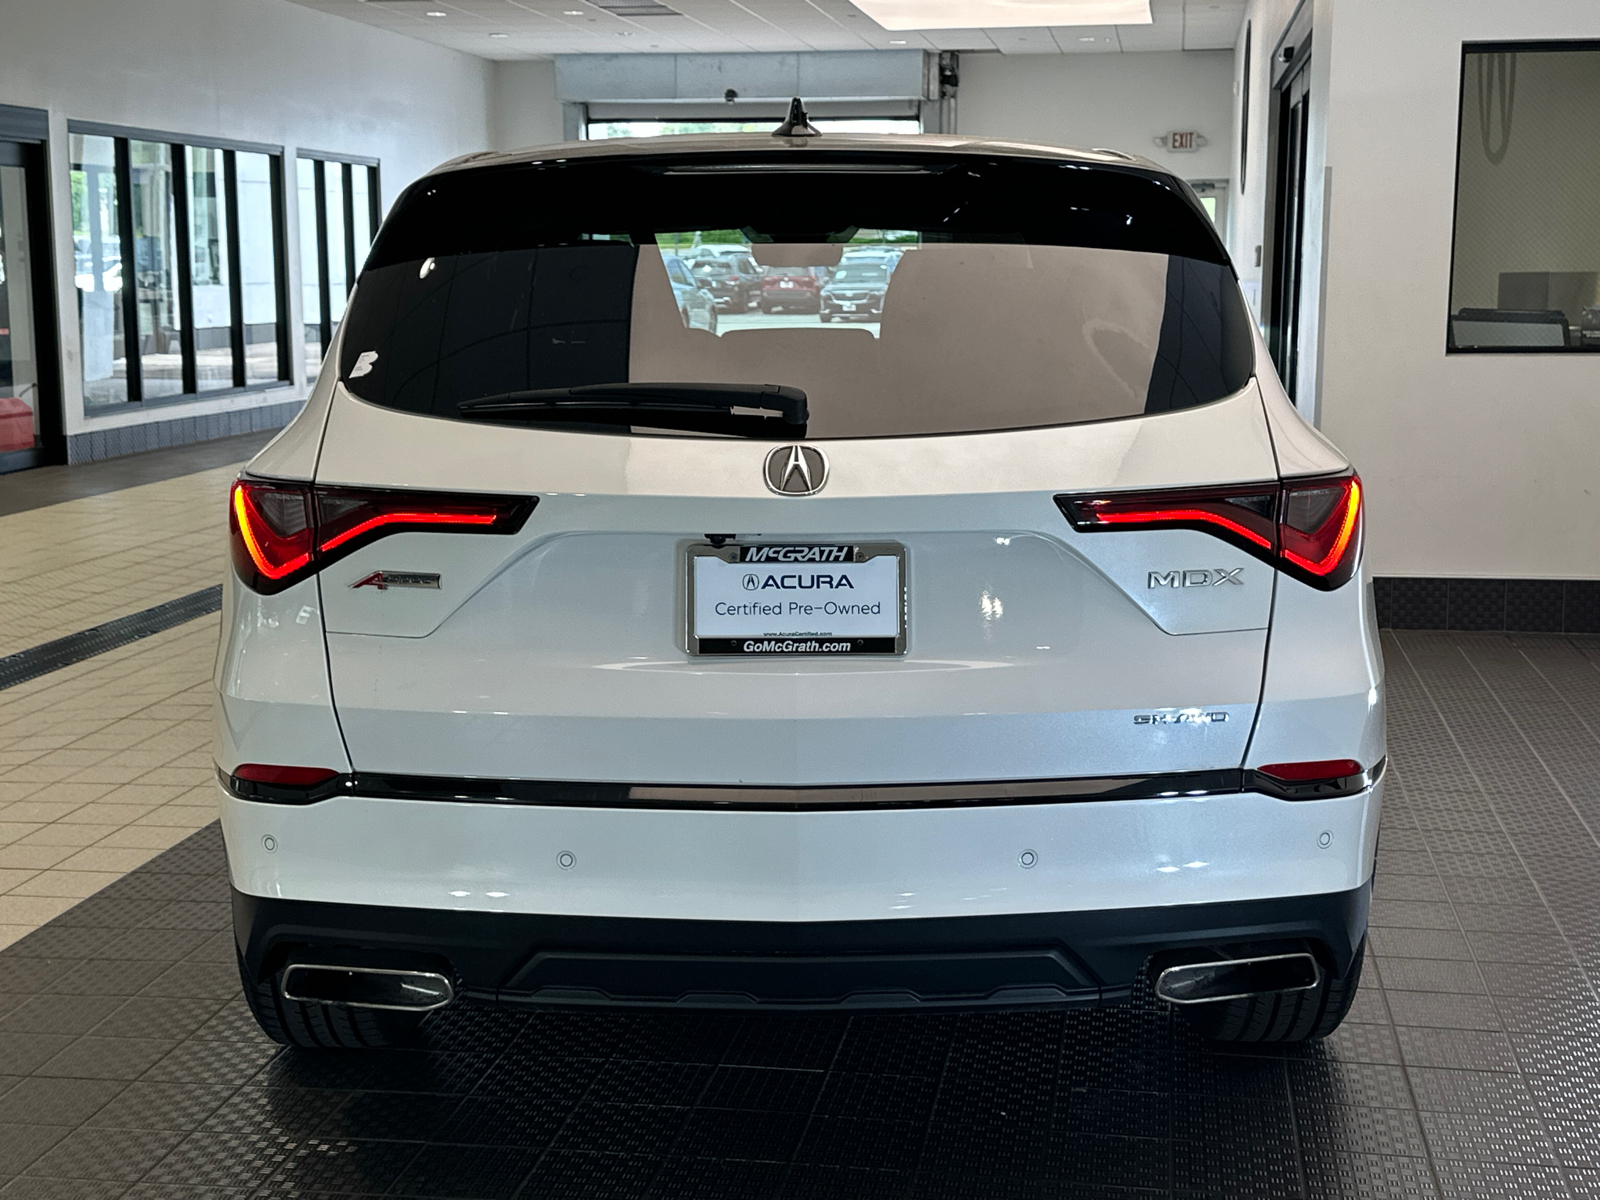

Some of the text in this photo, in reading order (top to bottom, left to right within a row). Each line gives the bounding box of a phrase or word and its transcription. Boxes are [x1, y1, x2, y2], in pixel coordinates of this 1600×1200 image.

[1172, 132, 1194, 149] EXIT
[761, 574, 855, 589] ACURA
[1148, 568, 1245, 589] MDX
[715, 601, 881, 616] Certified Pre-Owned
[743, 641, 851, 653] GoMcGrath.com
